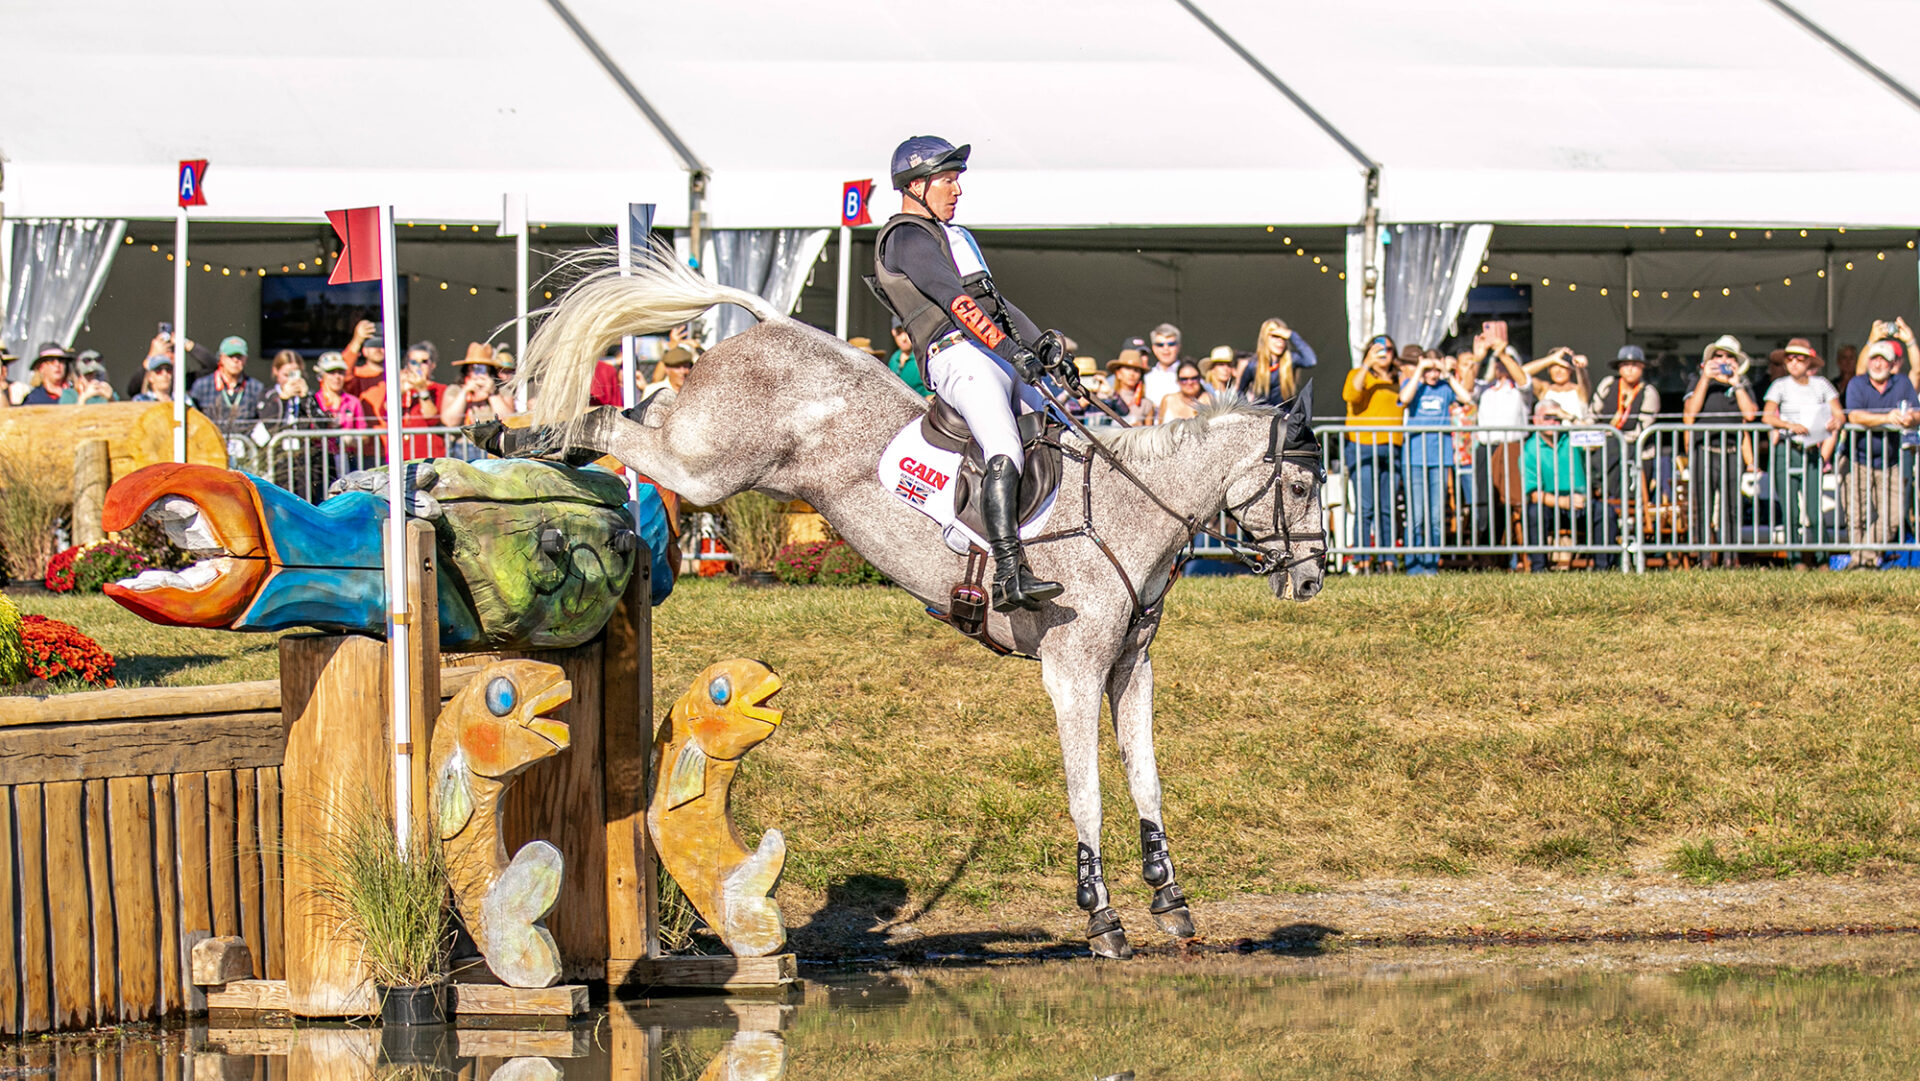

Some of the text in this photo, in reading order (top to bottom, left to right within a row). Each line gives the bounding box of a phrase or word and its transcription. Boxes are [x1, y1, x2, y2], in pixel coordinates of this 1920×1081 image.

[181, 167, 194, 196] A
[847, 191, 858, 216] B
[951, 294, 1007, 350] GAIN
[899, 456, 950, 491] GAIN
